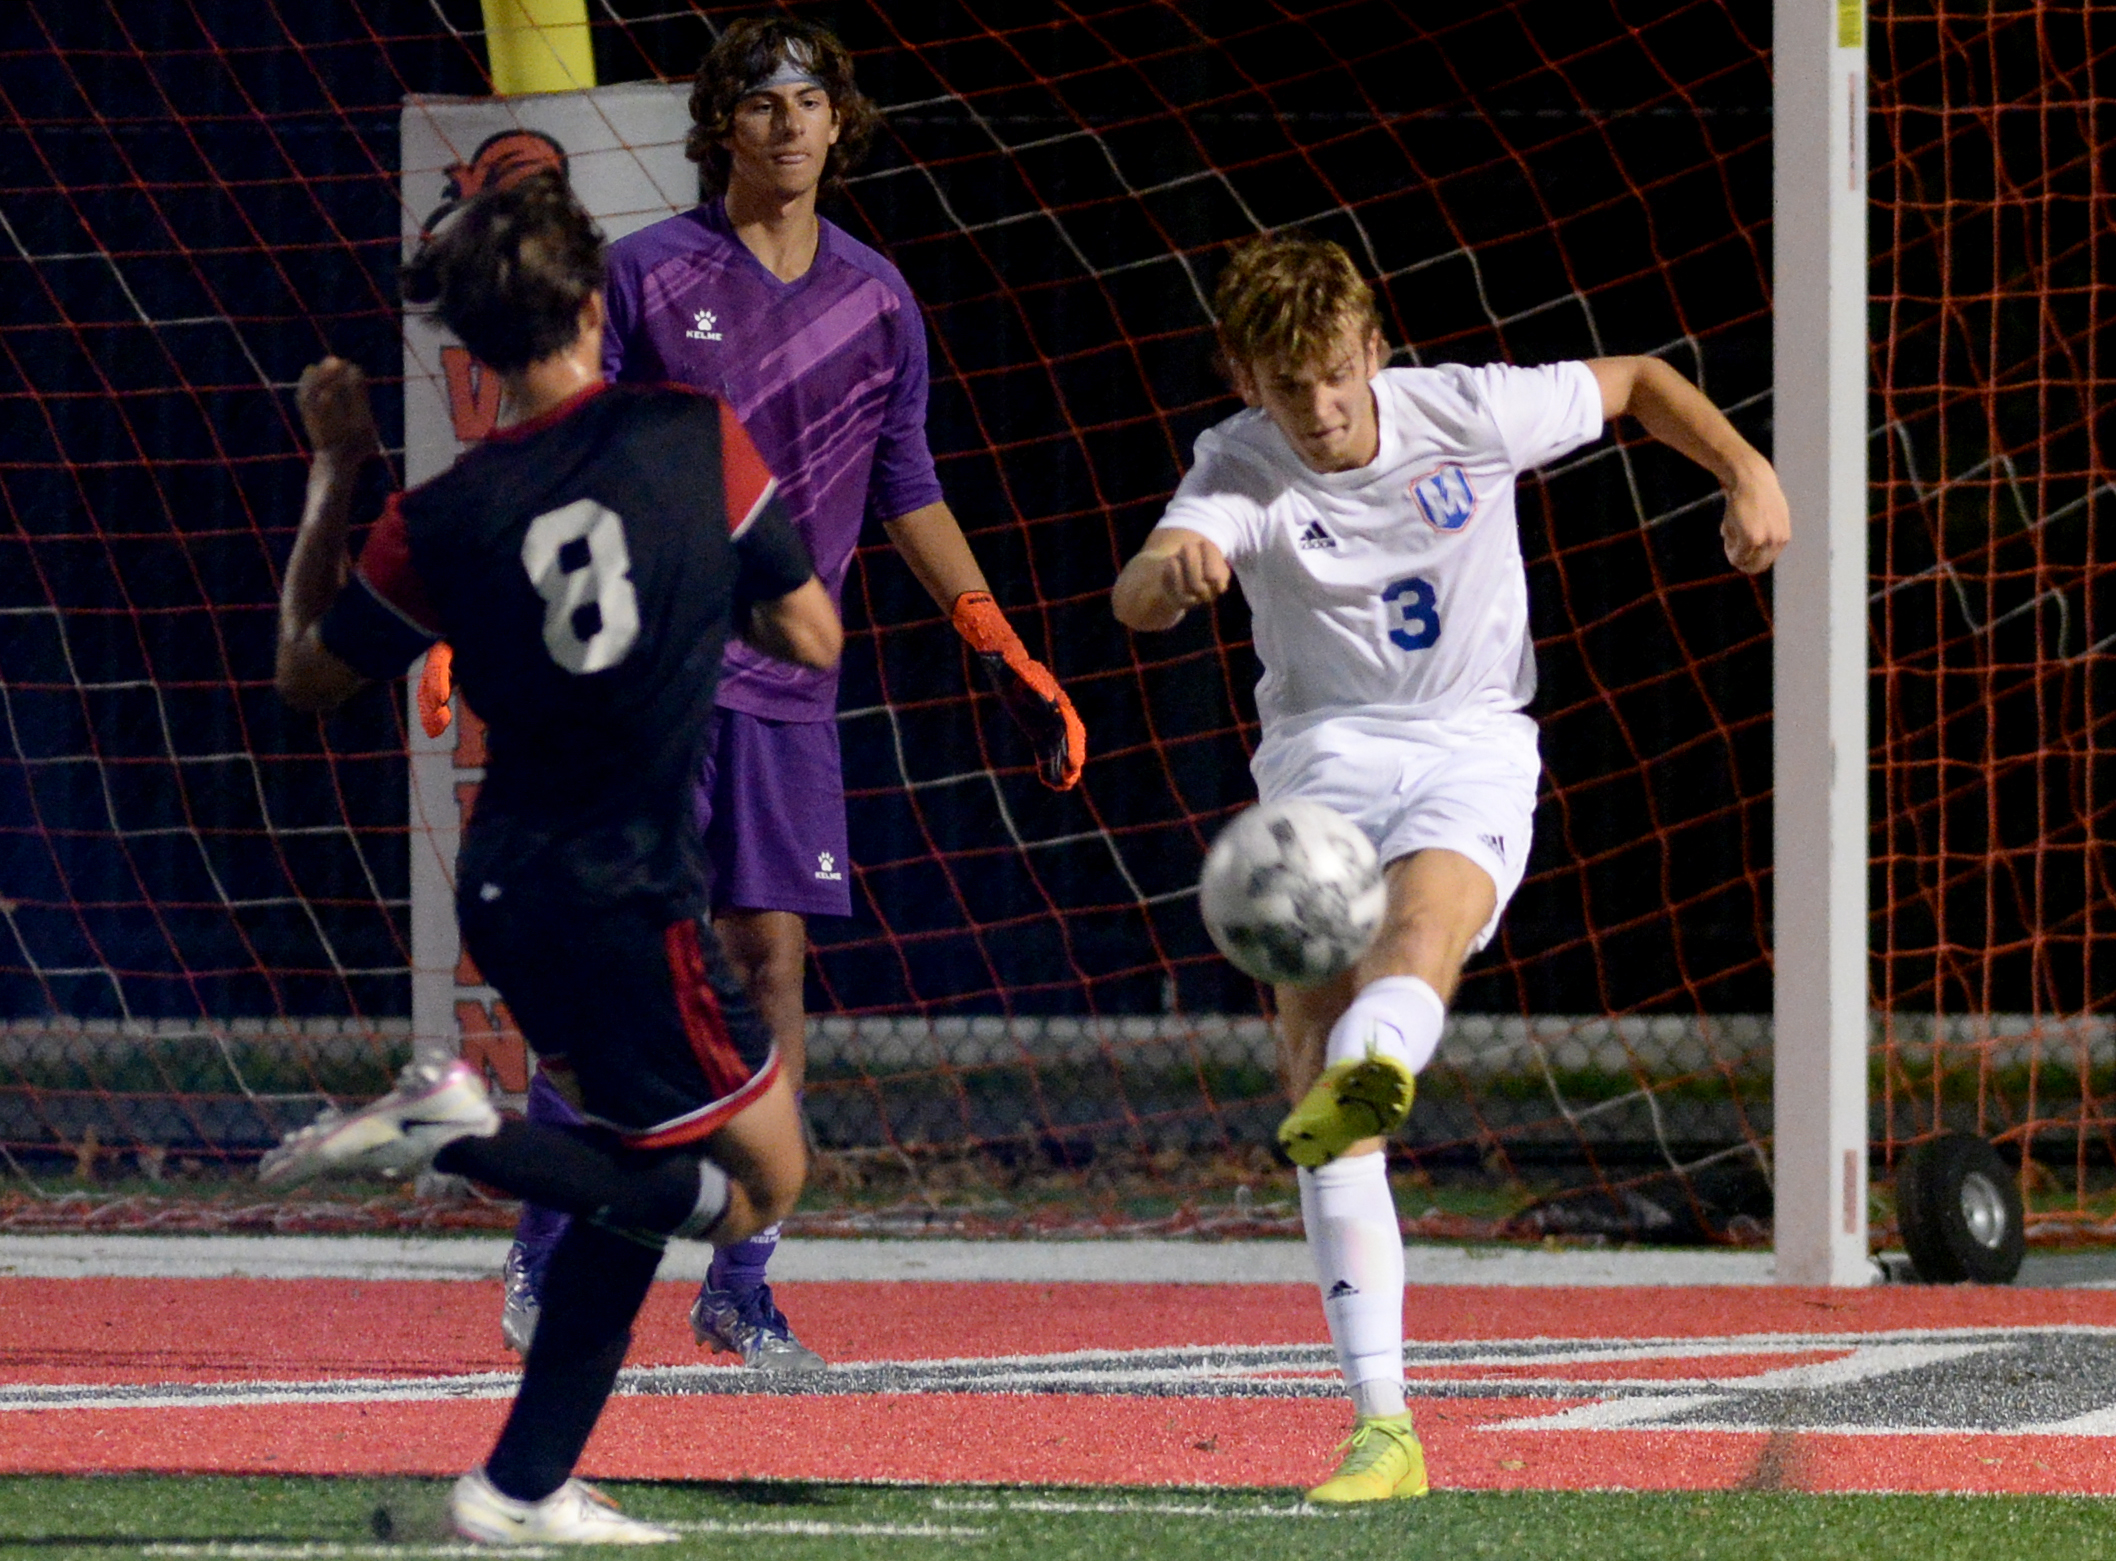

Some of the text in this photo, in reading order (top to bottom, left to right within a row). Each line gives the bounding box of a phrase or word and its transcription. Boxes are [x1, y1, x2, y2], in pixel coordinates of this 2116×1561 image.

[685, 330, 723, 341] KELME
[520, 498, 641, 674] 8
[1381, 577, 1442, 651] 3
[815, 871, 842, 880] KELME
